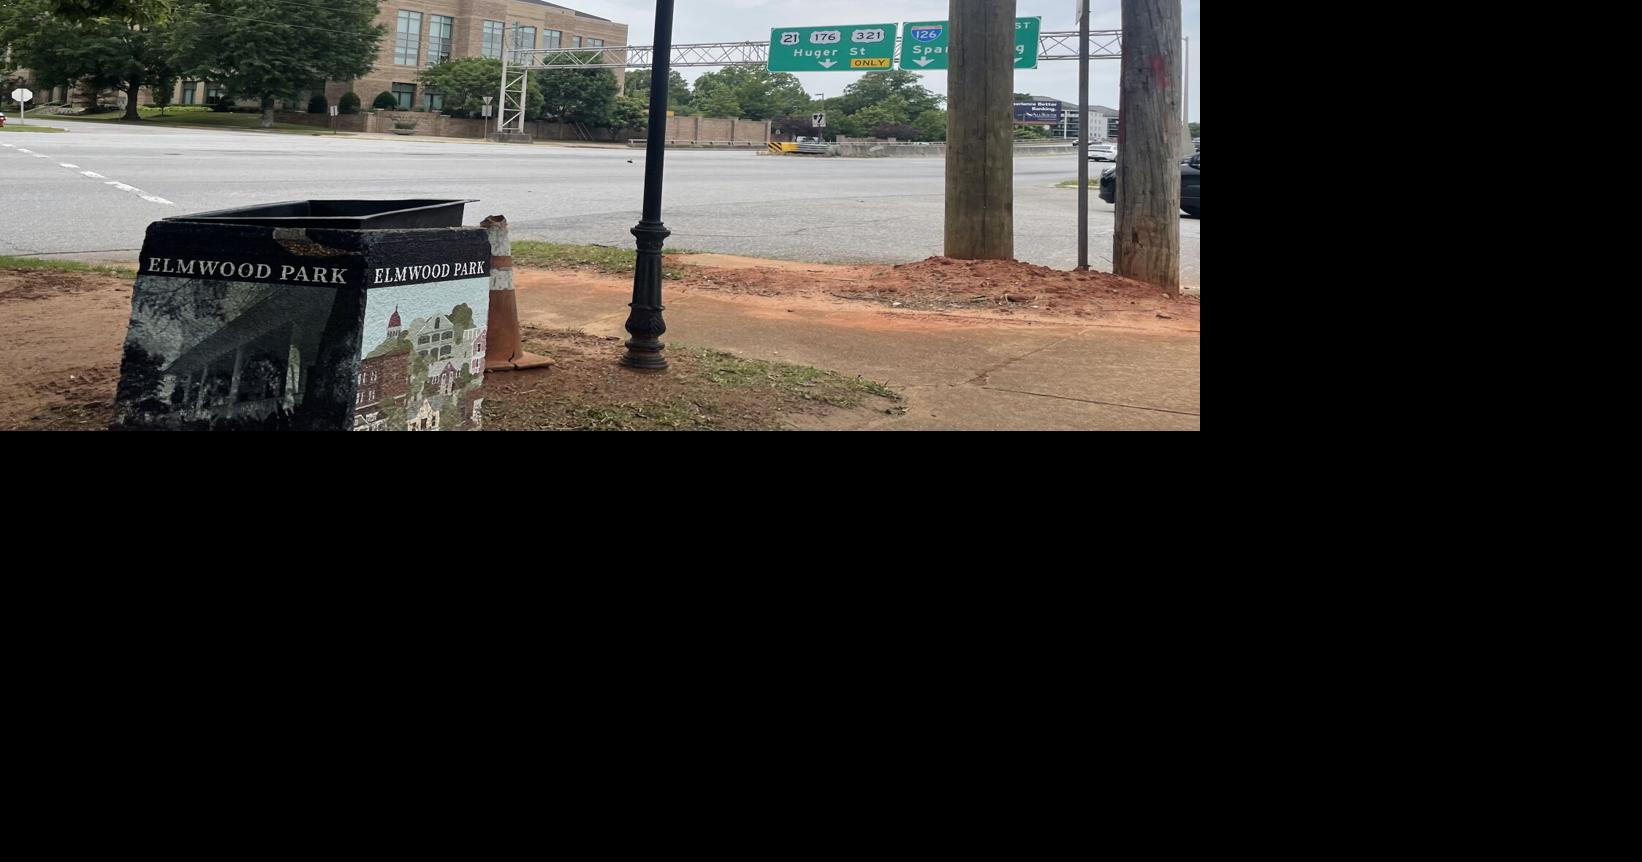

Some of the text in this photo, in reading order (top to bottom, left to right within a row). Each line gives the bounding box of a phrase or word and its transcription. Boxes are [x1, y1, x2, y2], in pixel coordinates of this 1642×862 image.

[1015, 22, 1031, 30] ST
[783, 32, 881, 43] 21 176 321
[916, 30, 937, 39] 126
[793, 47, 866, 59] Huger St
[854, 59, 885, 67] ONLY
[148, 257, 348, 284] ELMWOOD PARK
[373, 261, 485, 284] ELMWOOD PARK
